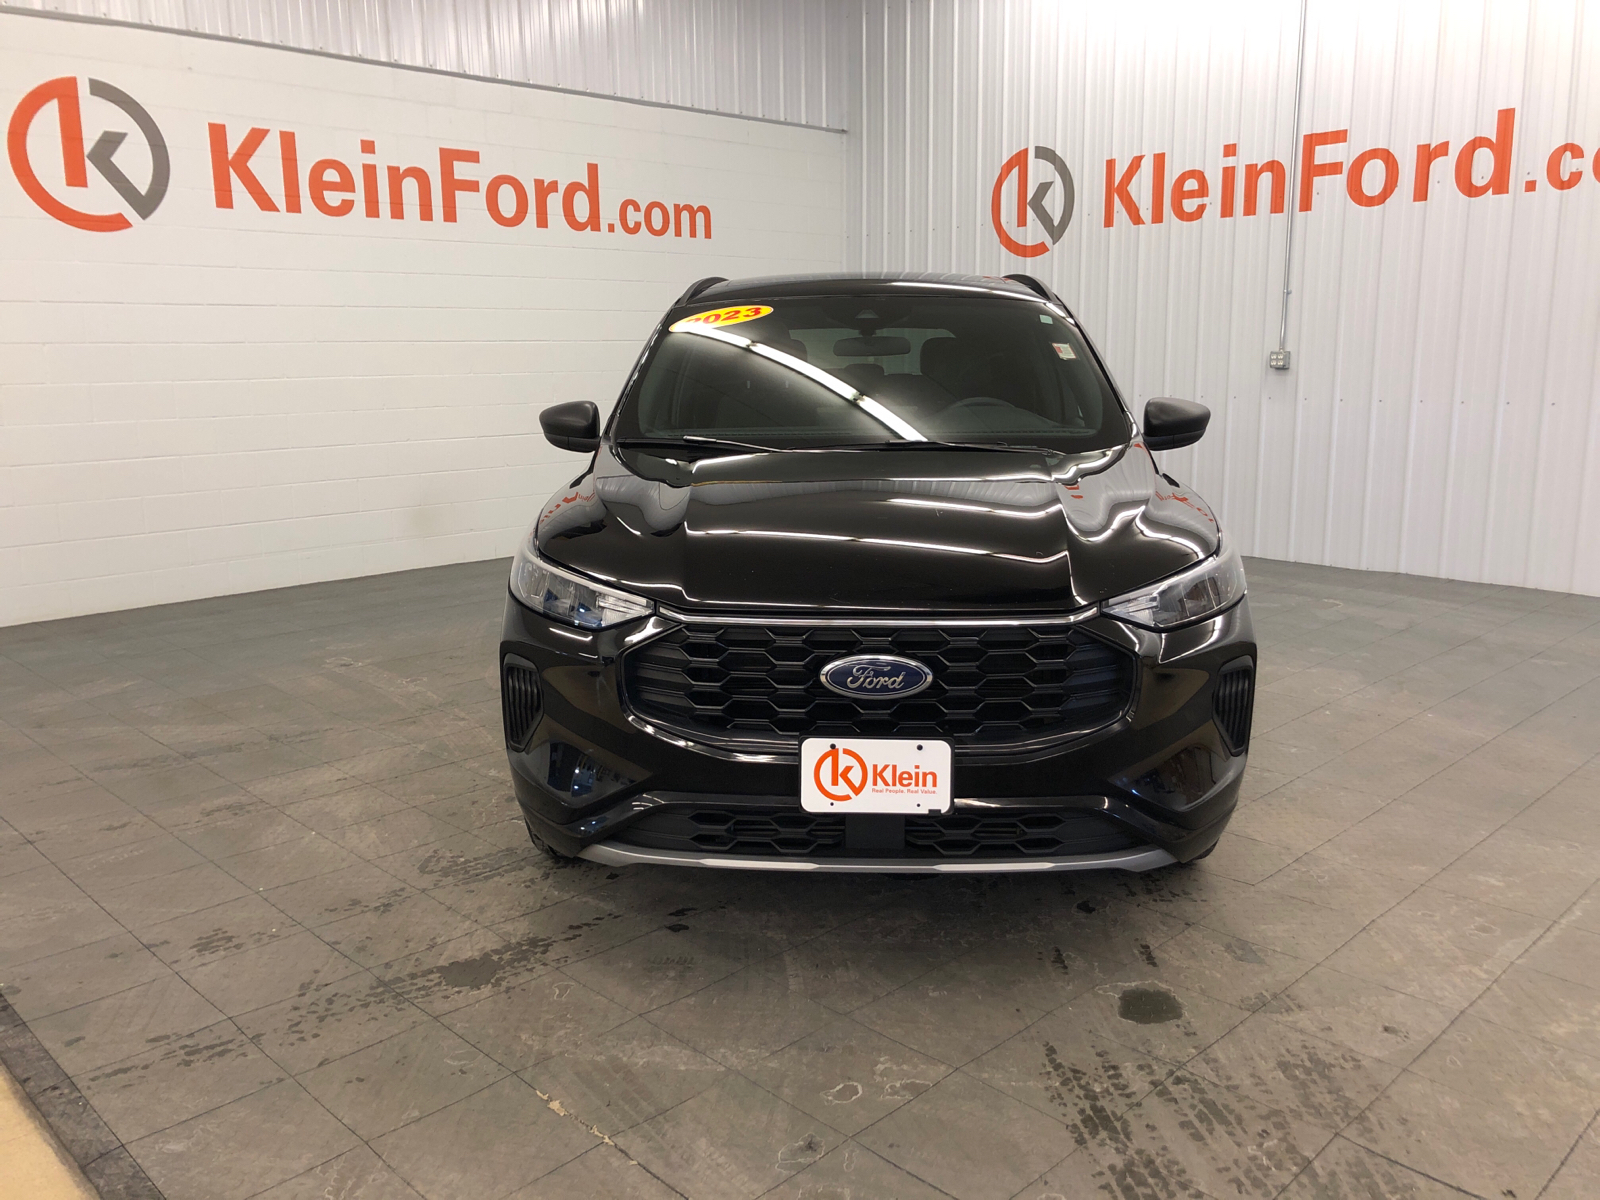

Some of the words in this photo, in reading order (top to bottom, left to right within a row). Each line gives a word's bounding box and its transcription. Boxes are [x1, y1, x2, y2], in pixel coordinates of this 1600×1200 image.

[207, 122, 713, 240] KleinFord.com
[846, 663, 907, 689] Ford
[872, 763, 938, 788] Klein
[885, 787, 906, 795] People.
